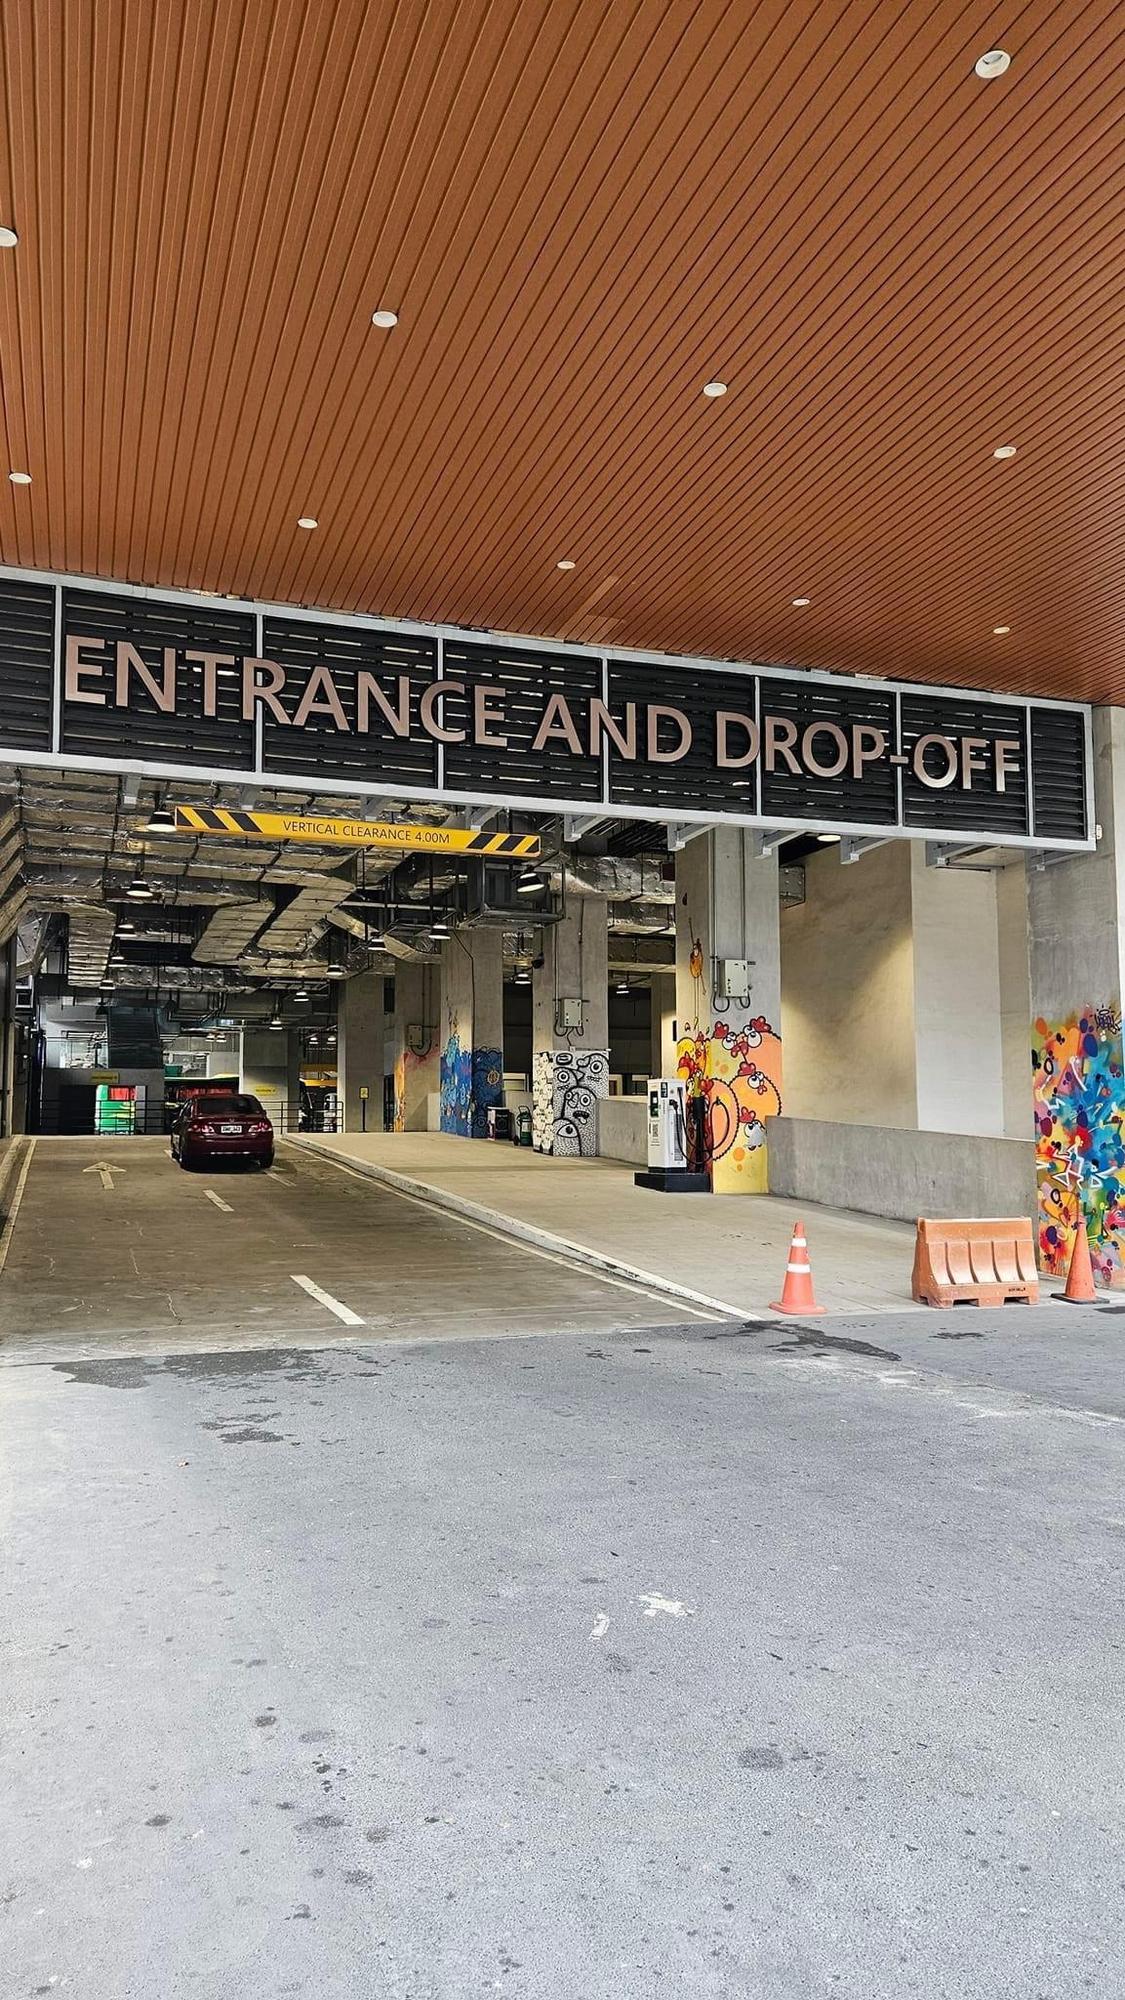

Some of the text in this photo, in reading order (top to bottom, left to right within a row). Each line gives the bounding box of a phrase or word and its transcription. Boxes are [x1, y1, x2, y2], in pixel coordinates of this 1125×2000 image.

[64, 633, 1021, 793] ENTRANCE AND DROP-OFF
[283, 820, 450, 844] VERTICAL CLEARANCE 4.00M
